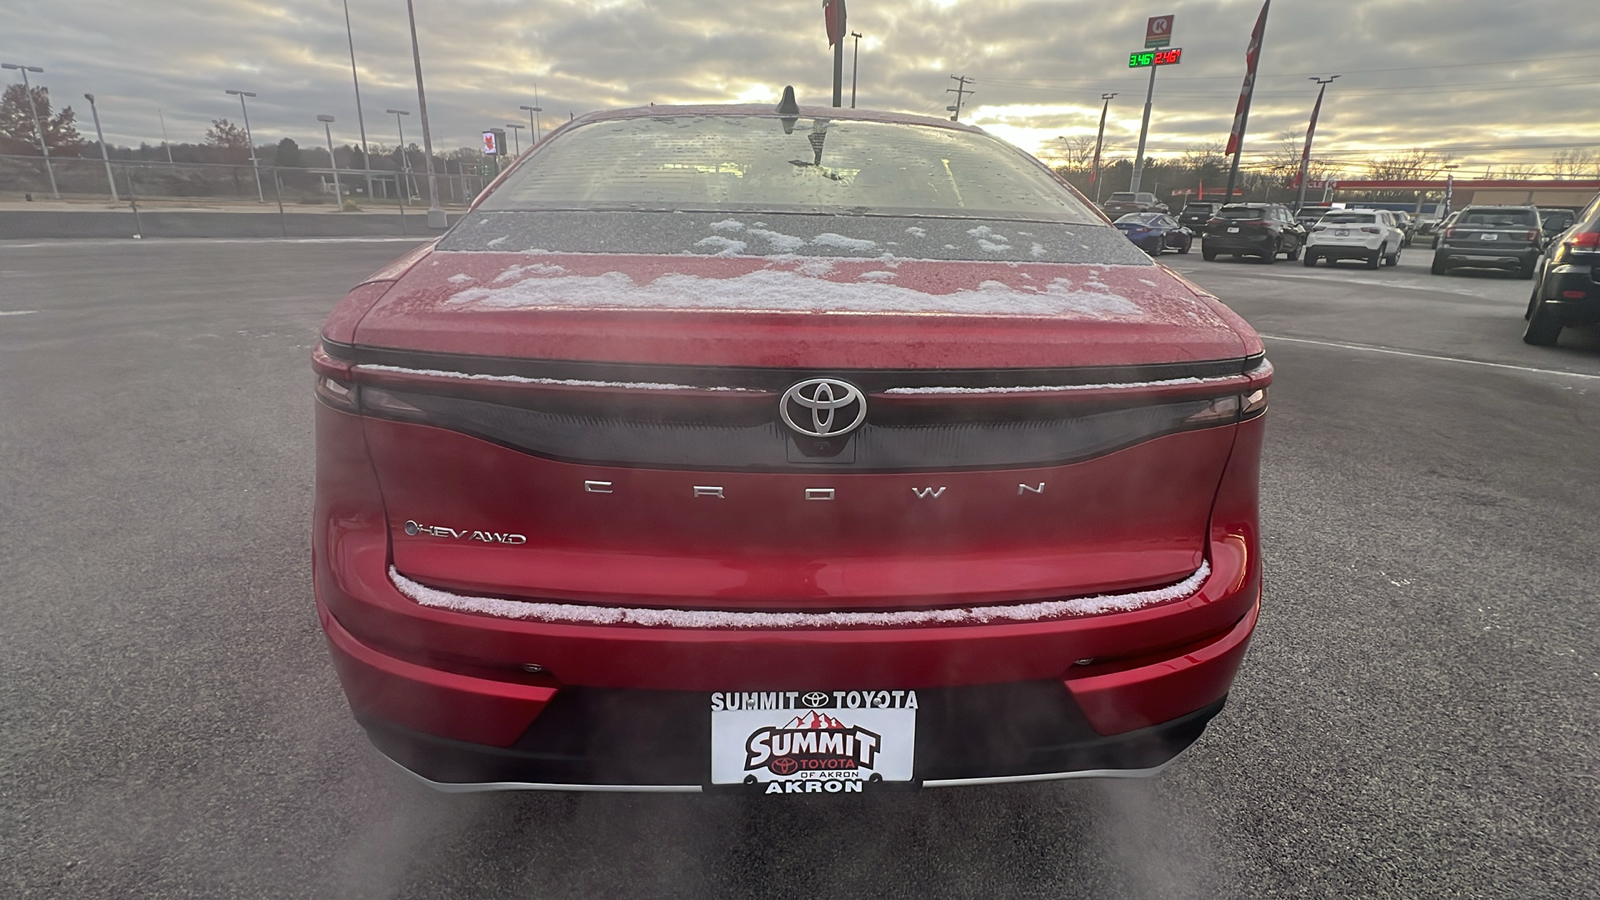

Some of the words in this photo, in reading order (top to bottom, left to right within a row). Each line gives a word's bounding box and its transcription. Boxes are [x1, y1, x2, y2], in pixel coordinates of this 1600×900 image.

[584, 480, 1045, 501] CROWN
[468, 530, 527, 545] AWD
[711, 692, 799, 711] SUMMIT
[833, 690, 918, 710] TOYOTA
[750, 730, 876, 767] SUMMIT
[800, 758, 855, 769] TOYOTA
[800, 771, 815, 779] OF
[819, 770, 859, 778] AKRON
[765, 780, 863, 794] AKRON
